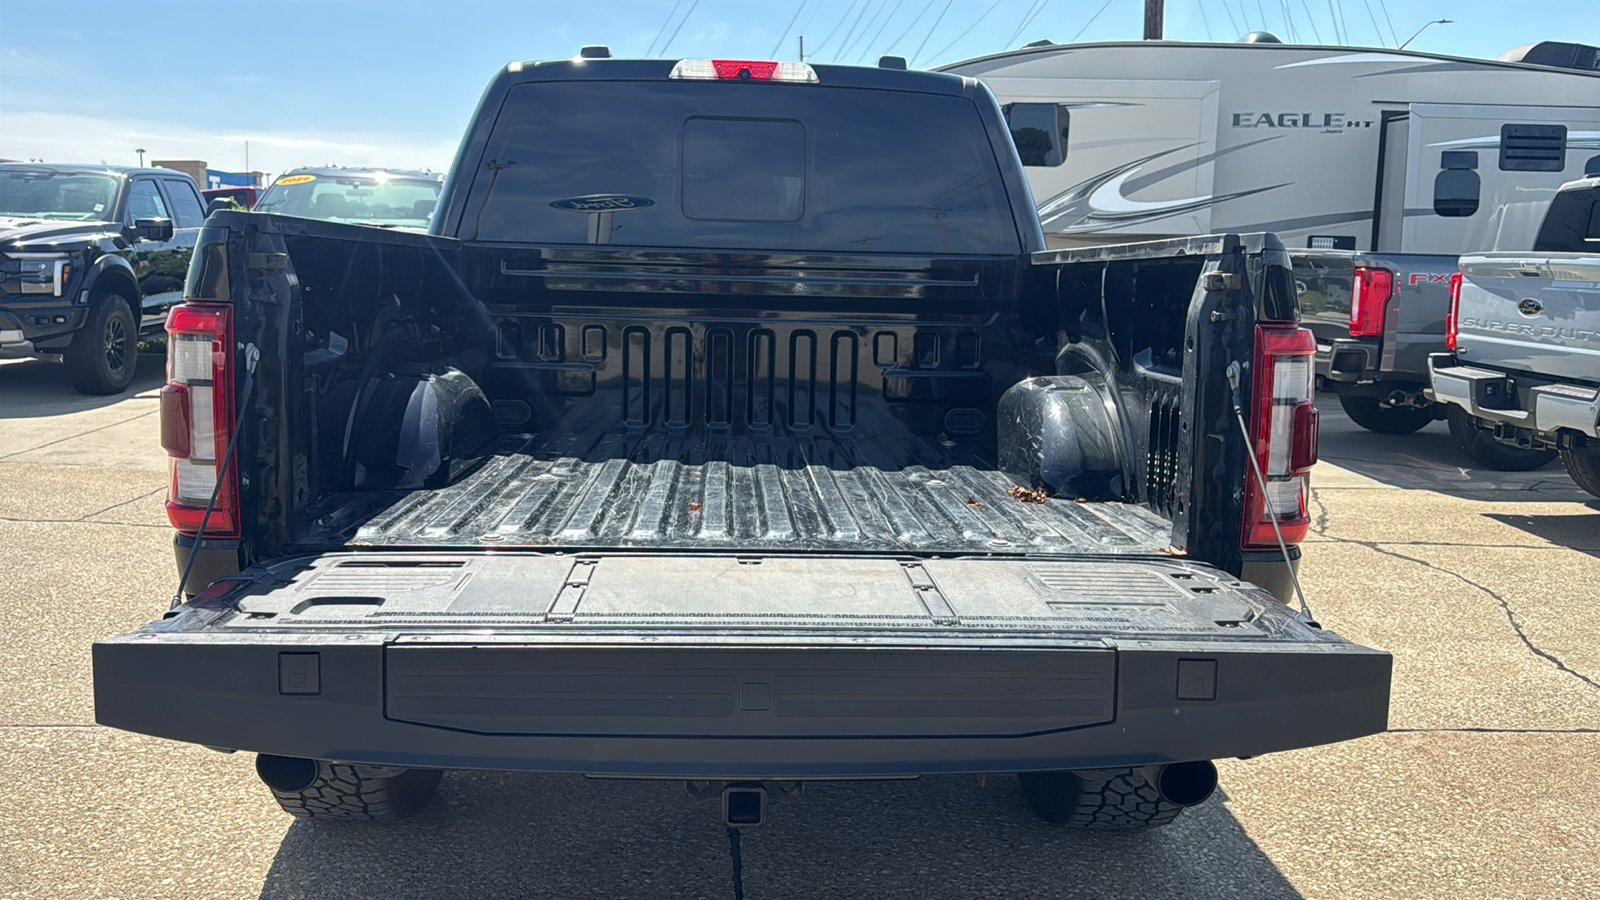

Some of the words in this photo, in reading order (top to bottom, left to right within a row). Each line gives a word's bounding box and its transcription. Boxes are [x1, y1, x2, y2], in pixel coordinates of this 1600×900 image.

[1232, 112, 1345, 128] EAGLE
[1408, 273, 1450, 285] FX
[1463, 317, 1534, 336] SUPER
